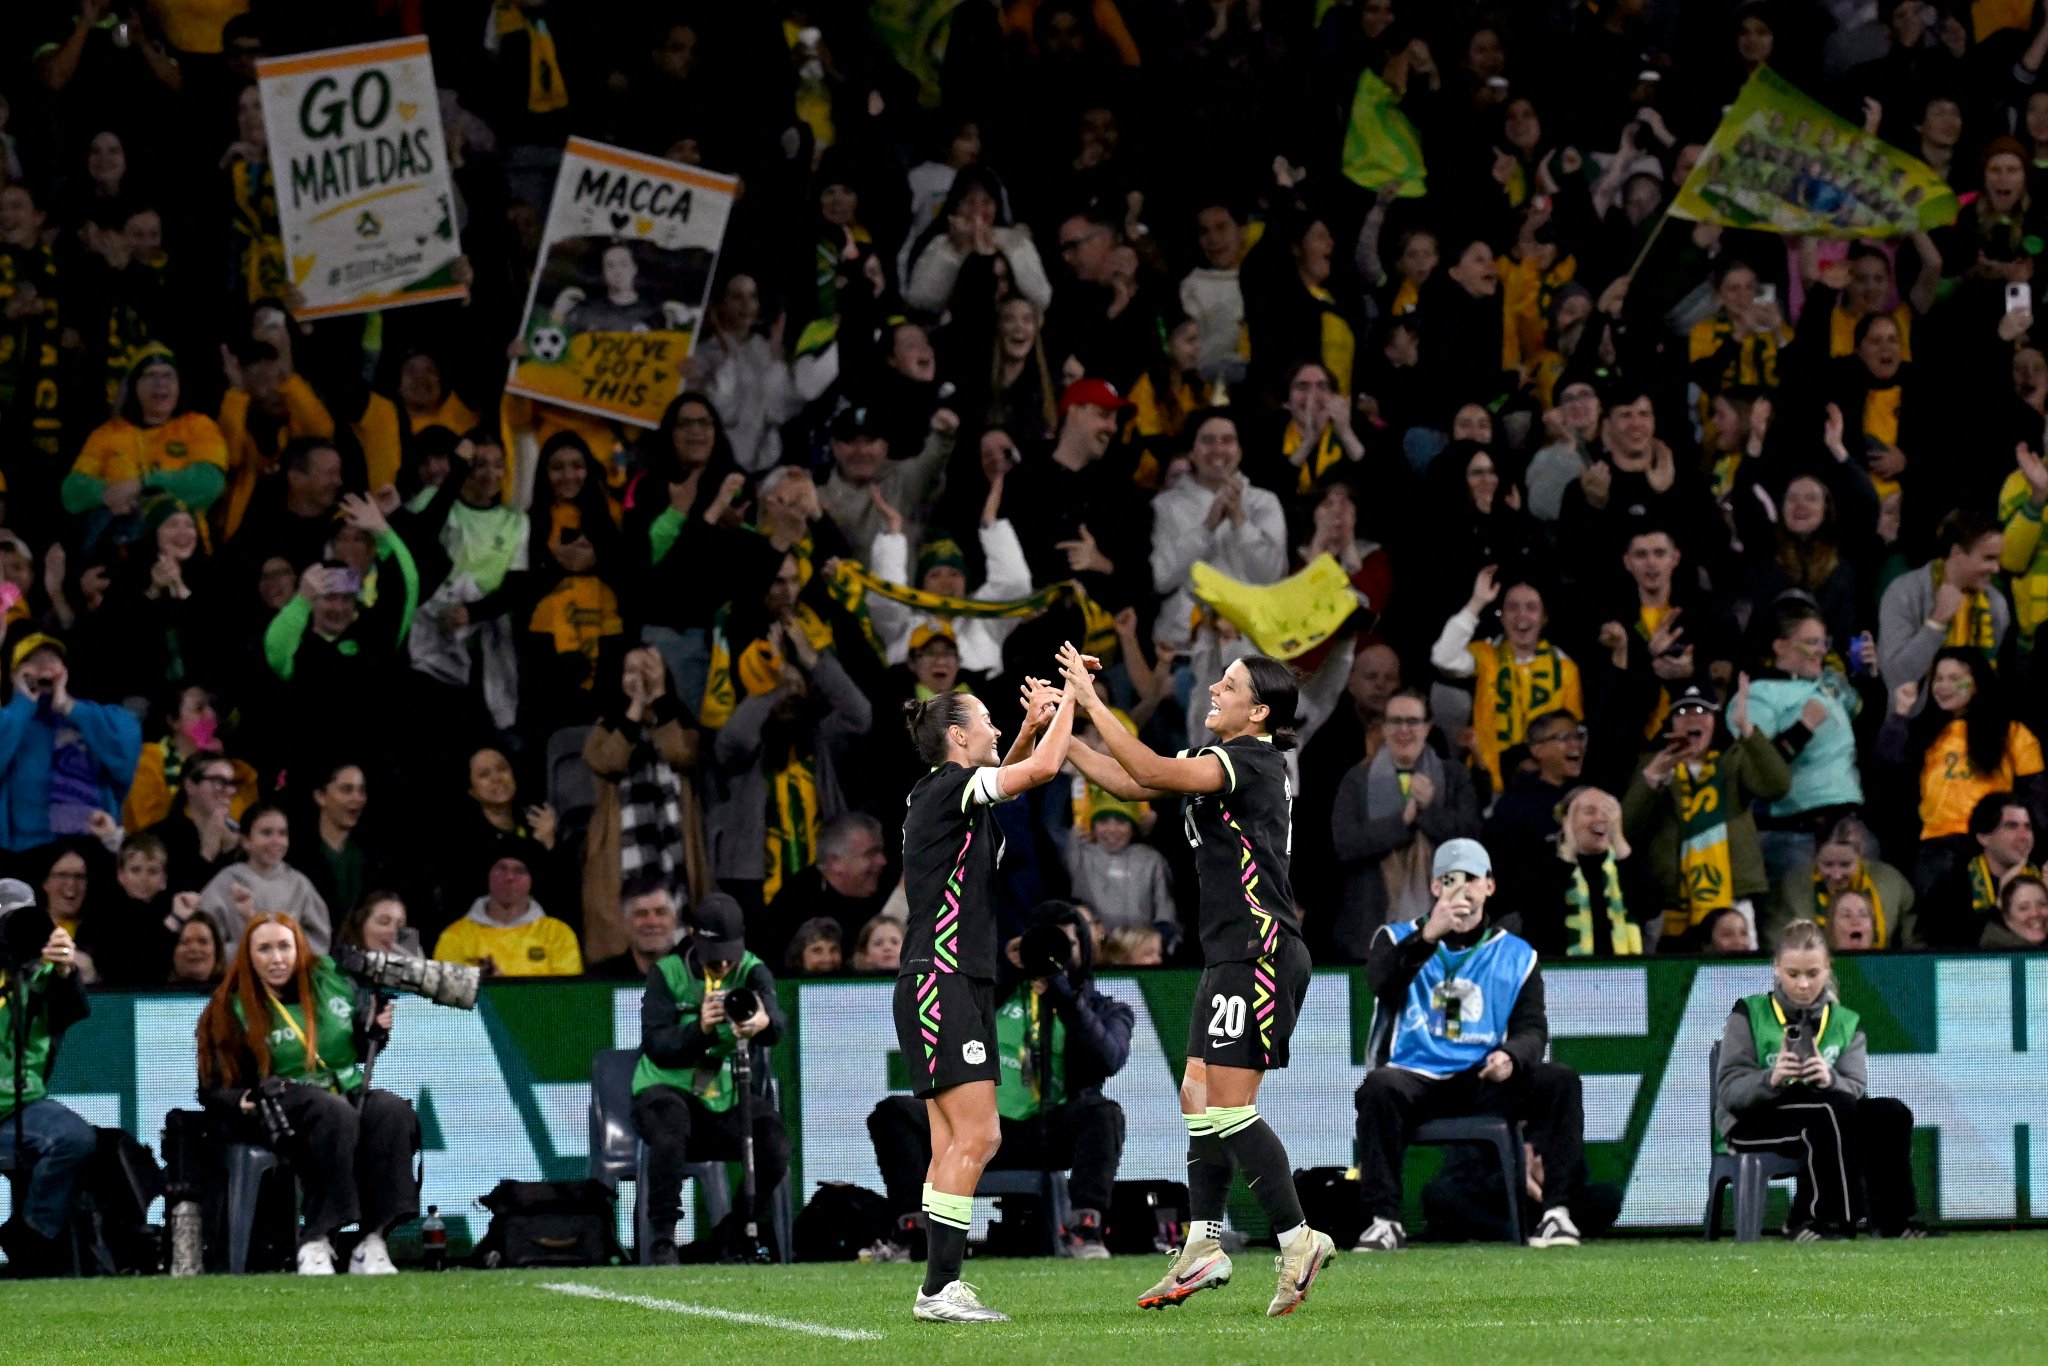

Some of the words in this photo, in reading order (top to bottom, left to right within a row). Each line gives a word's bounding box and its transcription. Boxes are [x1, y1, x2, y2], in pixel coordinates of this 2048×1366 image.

[300, 69, 391, 140] GO
[291, 128, 433, 209] MATILDAS
[575, 168, 693, 224] MACCA
[589, 333, 671, 361] YOU'VE
[595, 358, 644, 377] GOT
[582, 379, 649, 407] THIS
[1208, 993, 1247, 1039] 20
